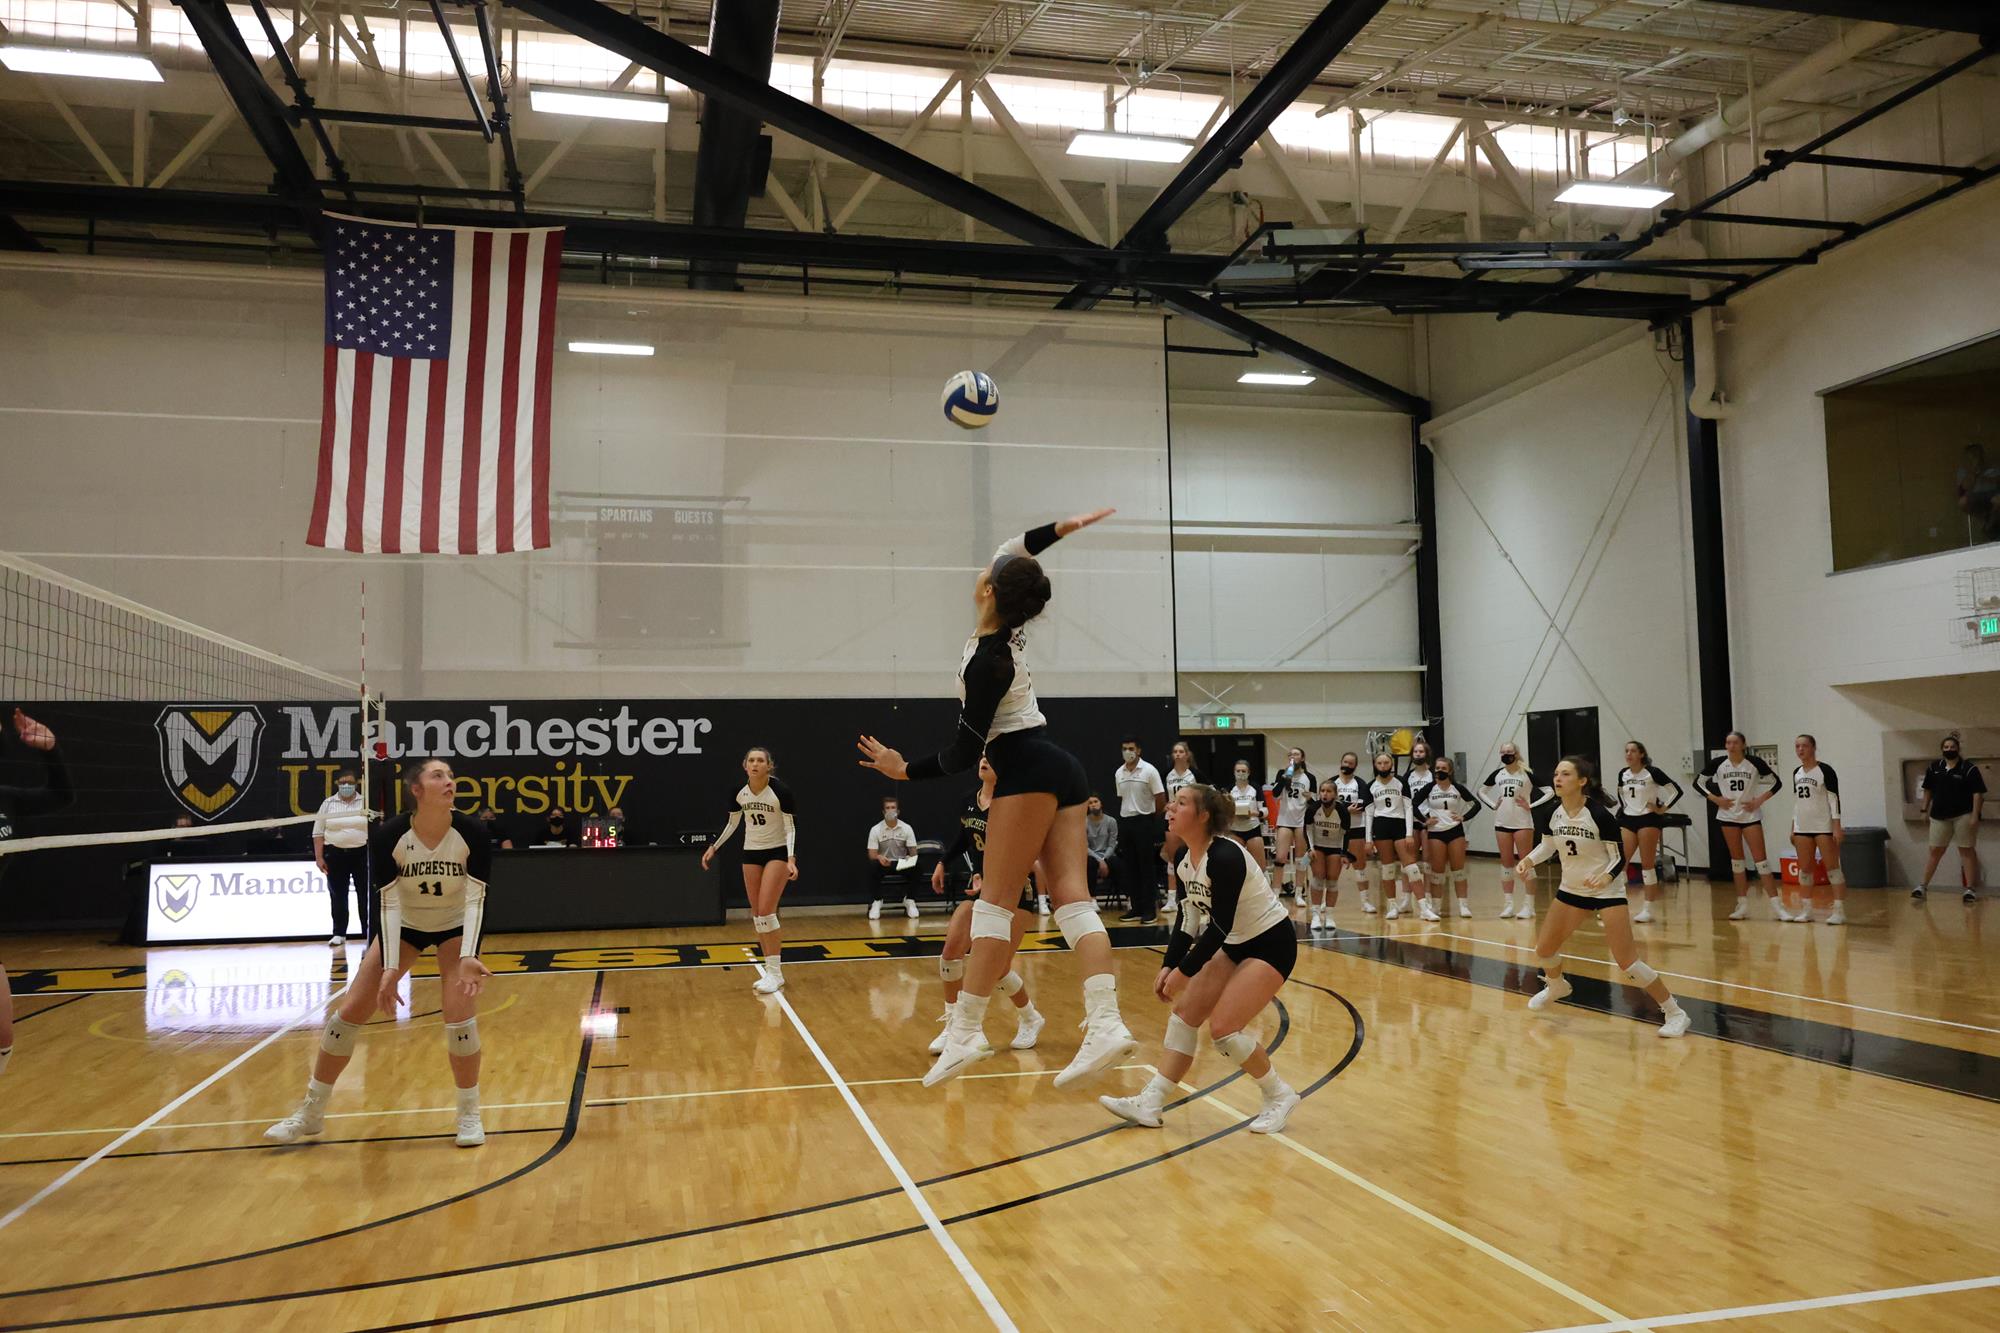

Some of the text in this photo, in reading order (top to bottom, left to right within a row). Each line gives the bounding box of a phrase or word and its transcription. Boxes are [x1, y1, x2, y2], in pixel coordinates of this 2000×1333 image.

[600, 508, 653, 522] SPARTANS
[674, 511, 714, 524] GUESTS
[1981, 618, 1998, 635] EXIT
[282, 705, 712, 759] Manchester
[282, 761, 633, 818] Uiersity
[1504, 786, 1515, 797] 15
[1730, 780, 1744, 791] 20
[1798, 786, 1810, 798] 23
[1288, 788, 1299, 799] 22
[1629, 787, 1635, 798] 7
[1385, 797, 1392, 808] 6
[1443, 800, 1449, 810] 1
[750, 813, 766, 826] 16
[608, 826, 617, 837] 5
[973, 832, 986, 851] 8
[1565, 840, 1578, 856] 3
[400, 860, 465, 877] MANCHESTER
[209, 871, 326, 896] Manch
[418, 881, 443, 896] 11
